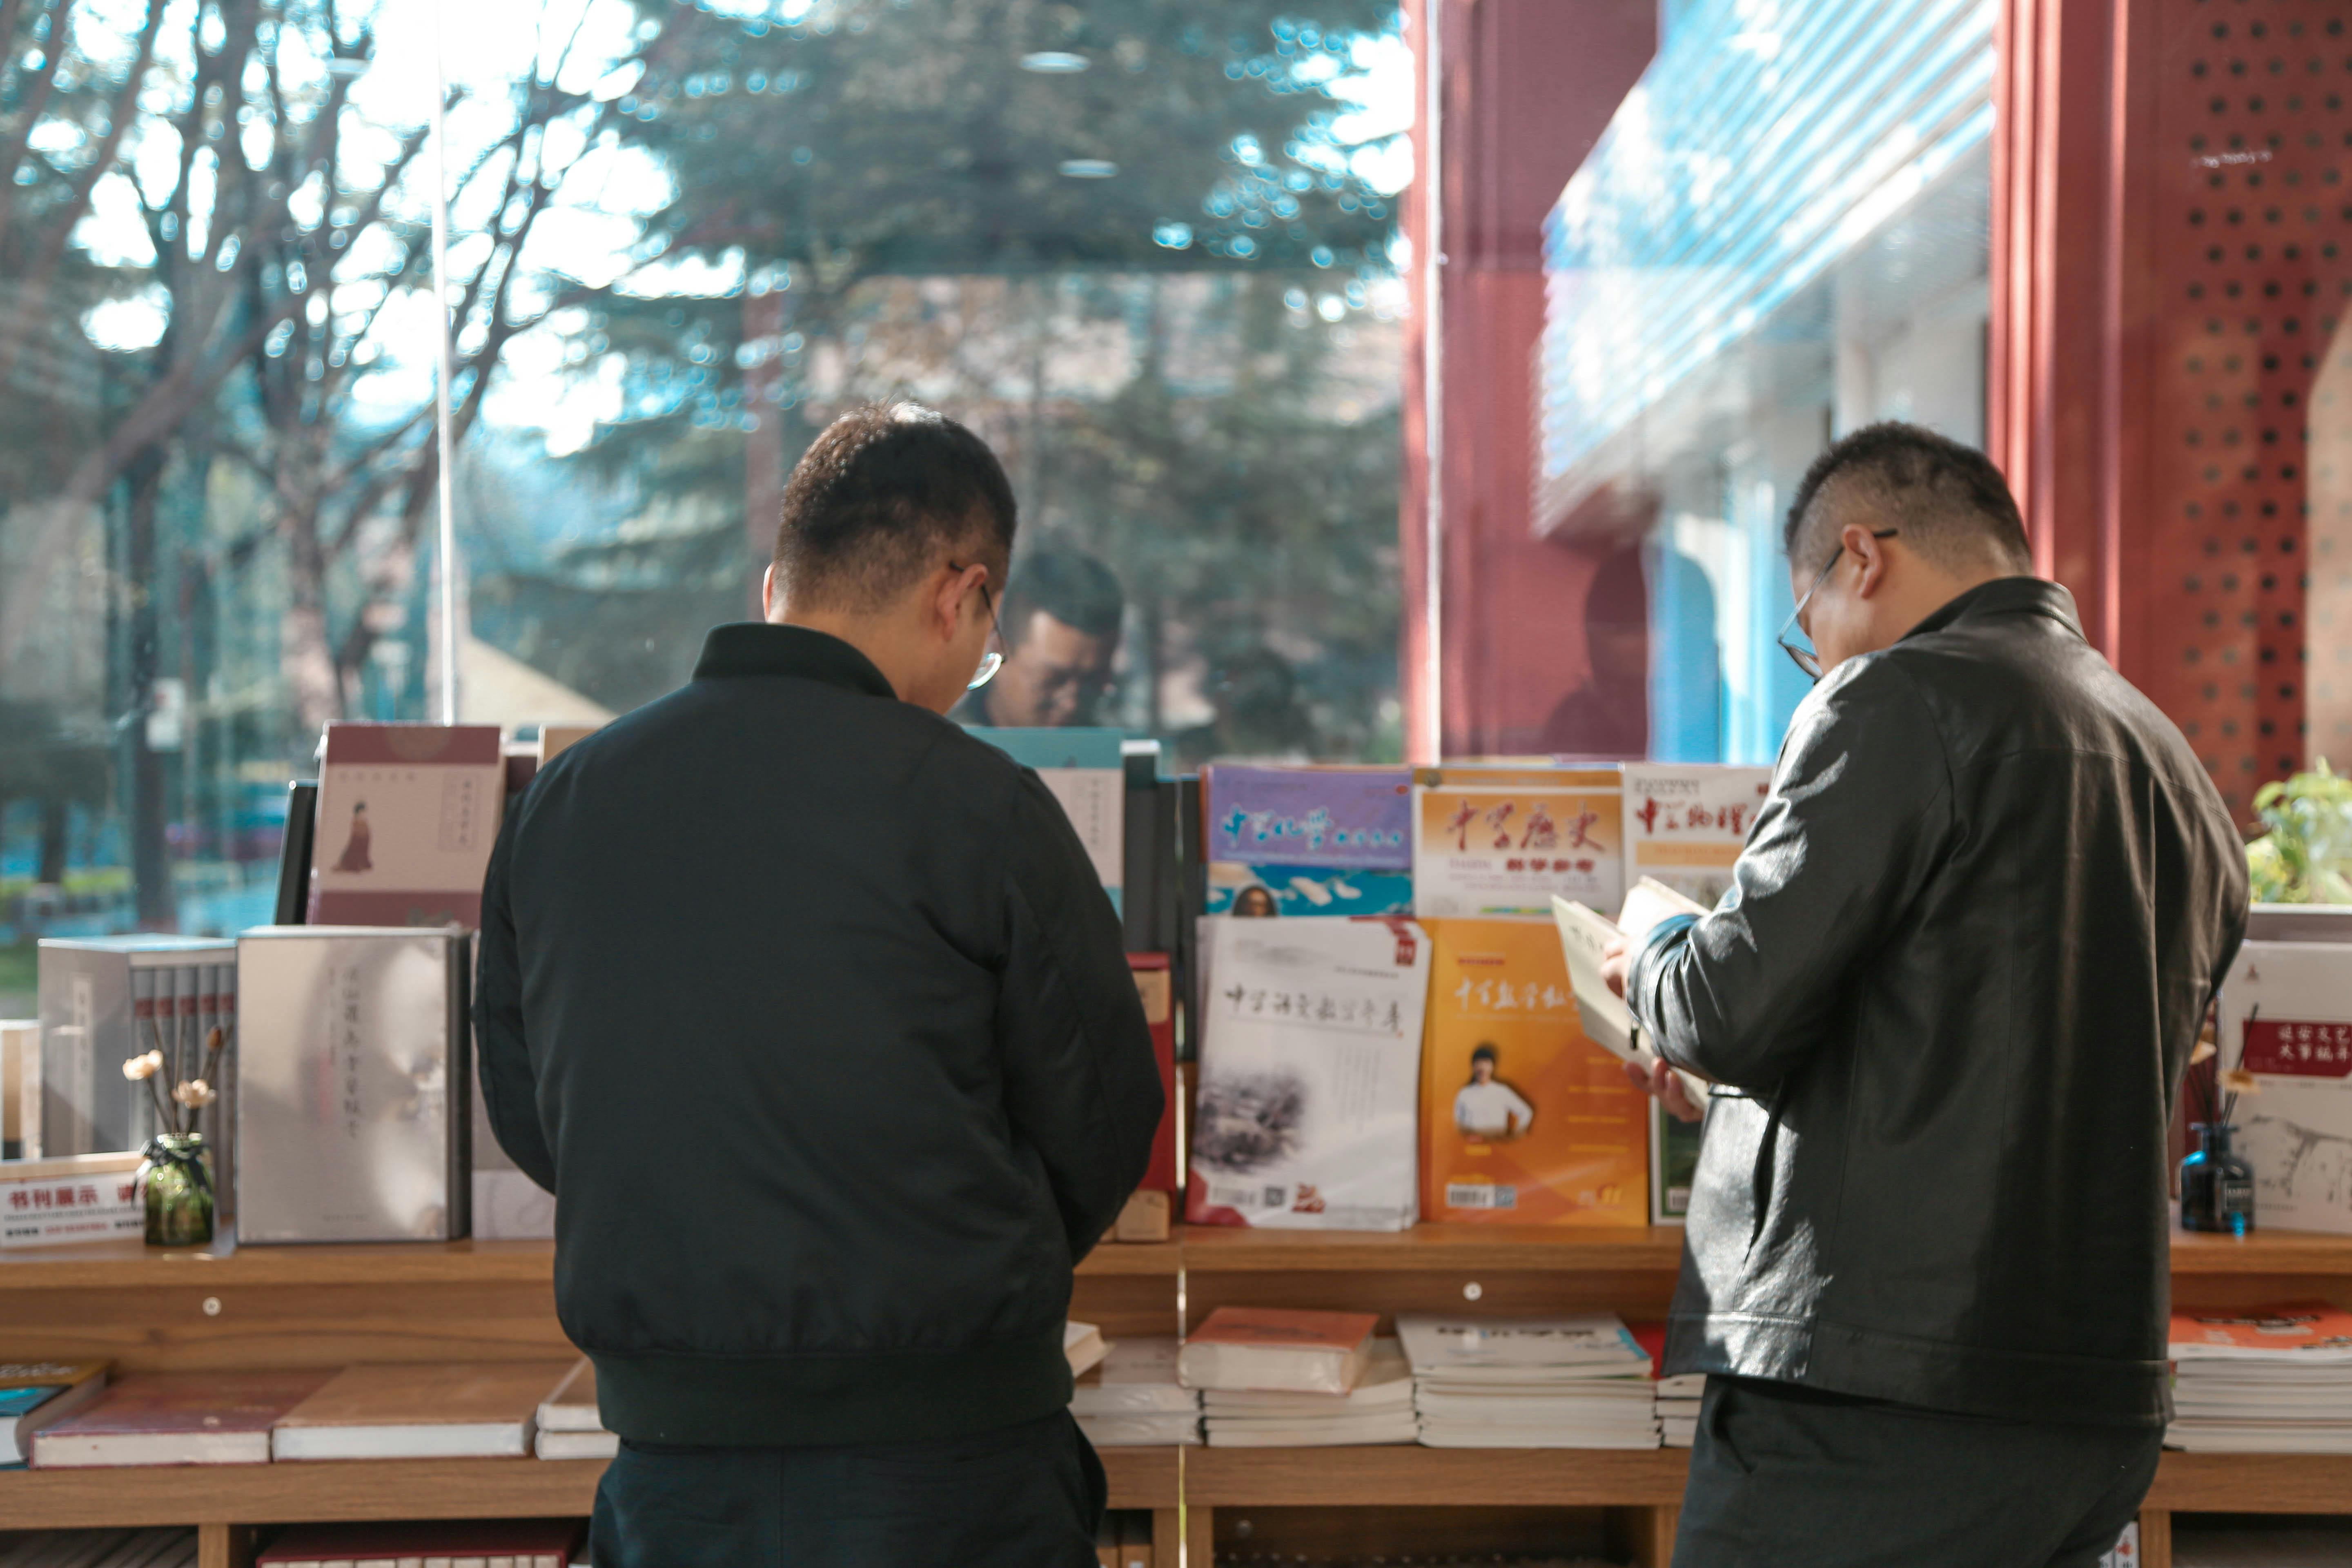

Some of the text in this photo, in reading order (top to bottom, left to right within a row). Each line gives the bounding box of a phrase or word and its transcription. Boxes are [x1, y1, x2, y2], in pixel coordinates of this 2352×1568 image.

[1635, 795, 1757, 835] 中学物理
[9, 1185, 98, 1210] 书刊展示
